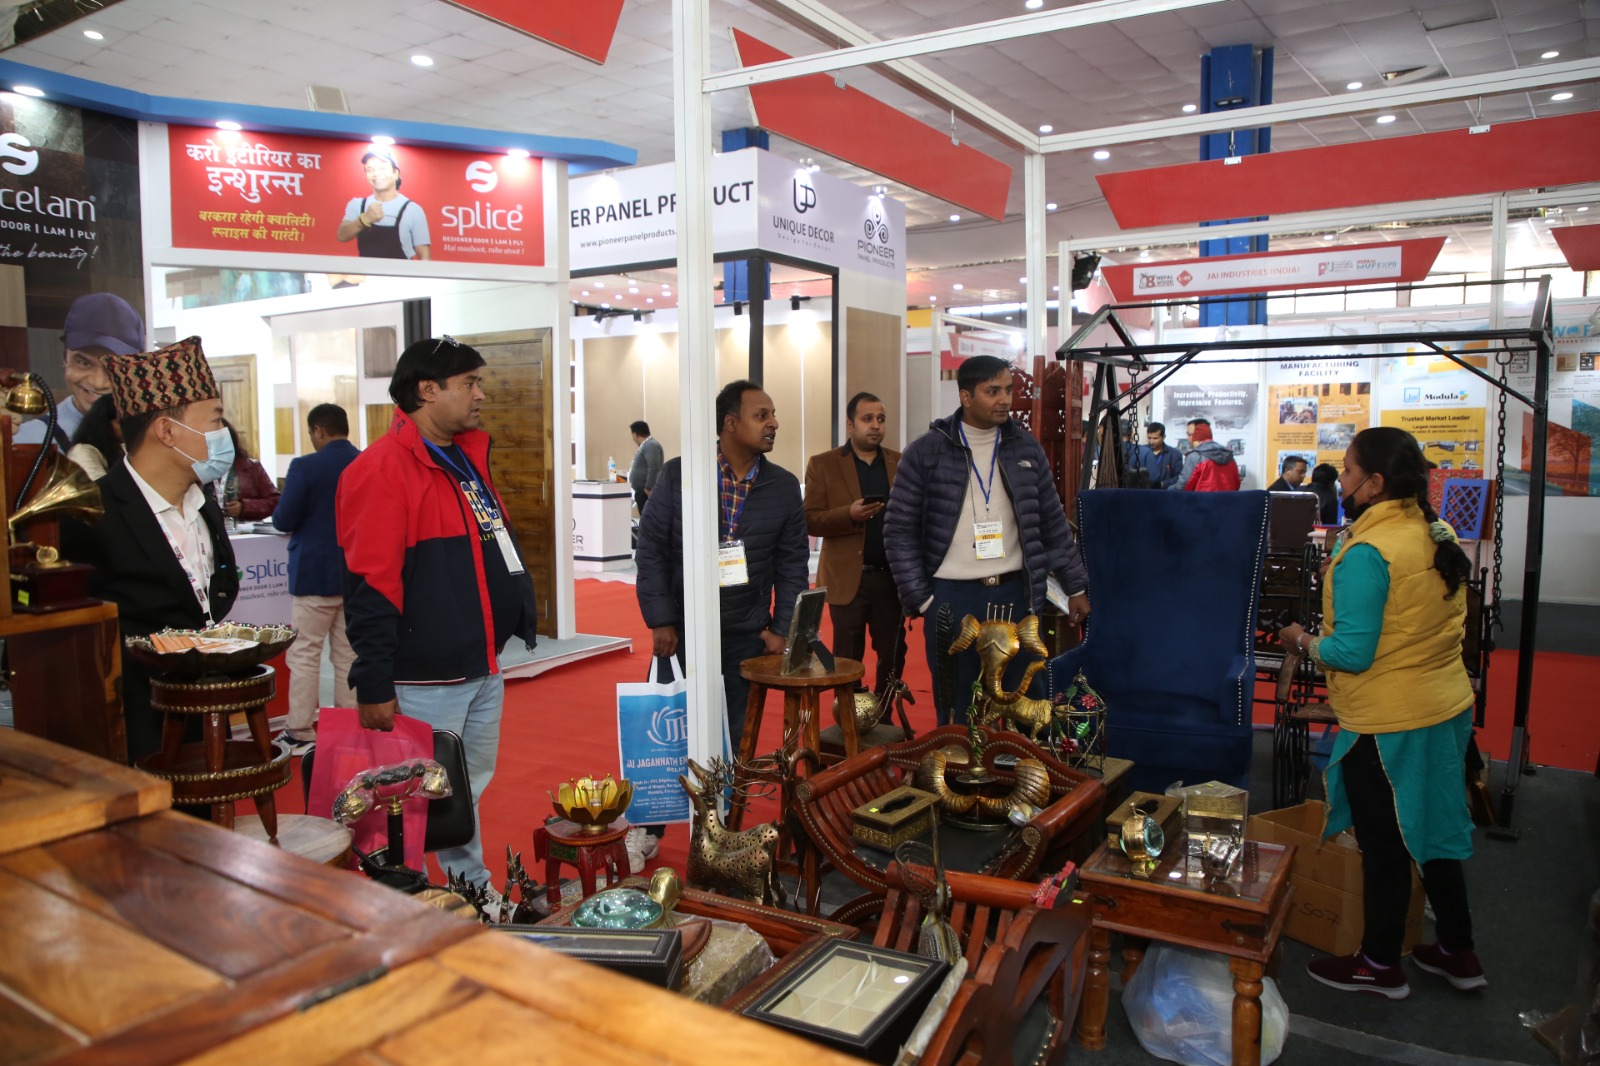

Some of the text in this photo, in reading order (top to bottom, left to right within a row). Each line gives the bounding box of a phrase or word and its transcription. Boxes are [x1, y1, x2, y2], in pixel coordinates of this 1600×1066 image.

[297, 152, 322, 170] का
[206, 166, 304, 204] इन्शुरन्स
[240, 209, 265, 226] रहेगी
[441, 200, 524, 236] splice
[596, 199, 653, 224] PANEL
[1, 219, 96, 241] DOOR LAM PLY
[252, 226, 267, 240] की
[773, 215, 835, 243] UNIQUE DECOR
[444, 244, 456, 252] Hai
[857, 240, 895, 260] PIONEER
[1206, 265, 1300, 280] JAI INDUSTRIES (INDIA)
[1280, 359, 1359, 370] MANUFACTURING
[1298, 369, 1339, 377] FACILITY
[1174, 390, 1205, 399] Incredible
[1424, 392, 1459, 401] Modula
[1177, 399, 1211, 407] Impressive
[637, 756, 678, 768] JAGANNATH
